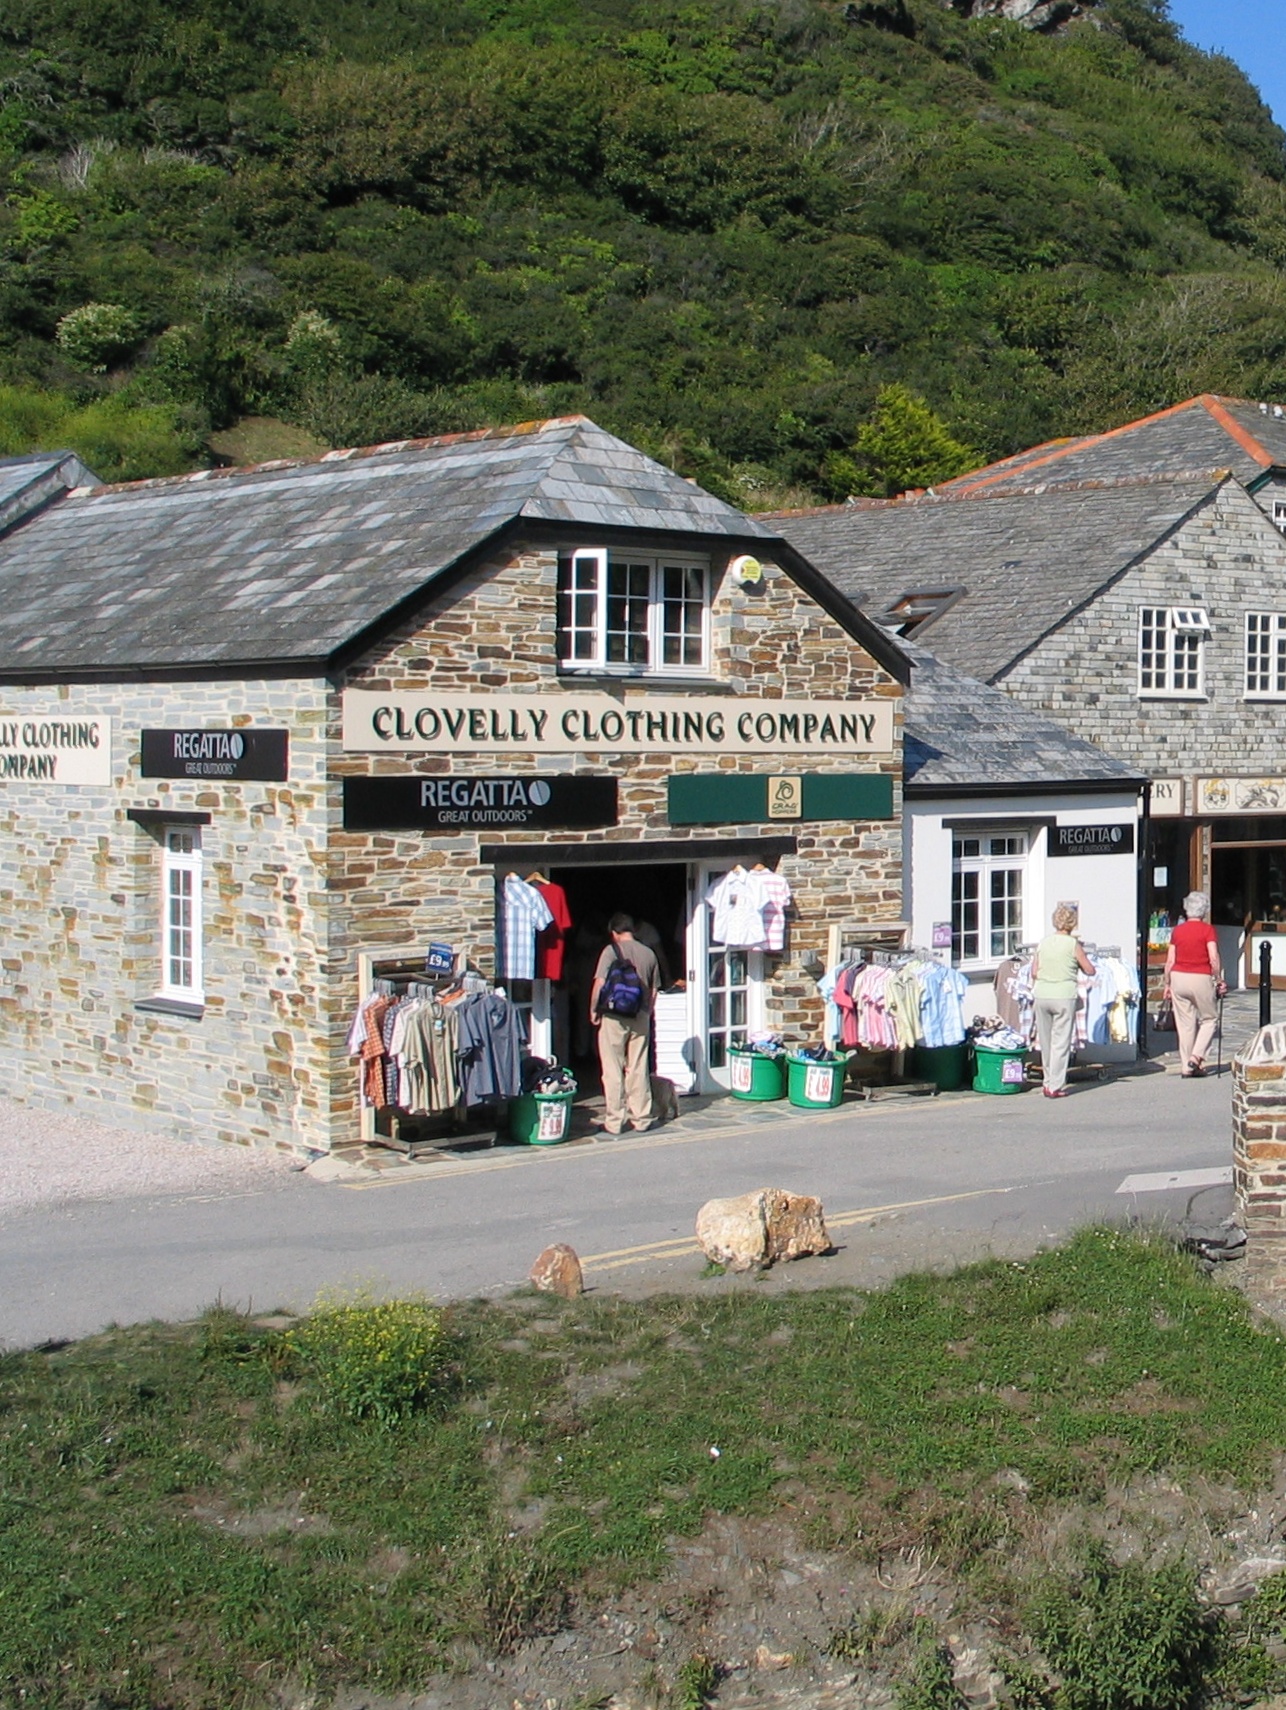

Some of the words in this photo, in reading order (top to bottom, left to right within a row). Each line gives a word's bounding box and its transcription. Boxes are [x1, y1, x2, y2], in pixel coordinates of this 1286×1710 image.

[23, 722, 100, 749] CLOTHING
[371, 706, 549, 742] CLOVELLY
[561, 708, 726, 743] CLOTHING
[737, 711, 877, 744] COMPANY
[173, 732, 231, 759] REGATTA
[420, 780, 528, 807] REGATTA
[438, 809, 470, 823] GREAT
[1059, 827, 1112, 845] REGATTA
